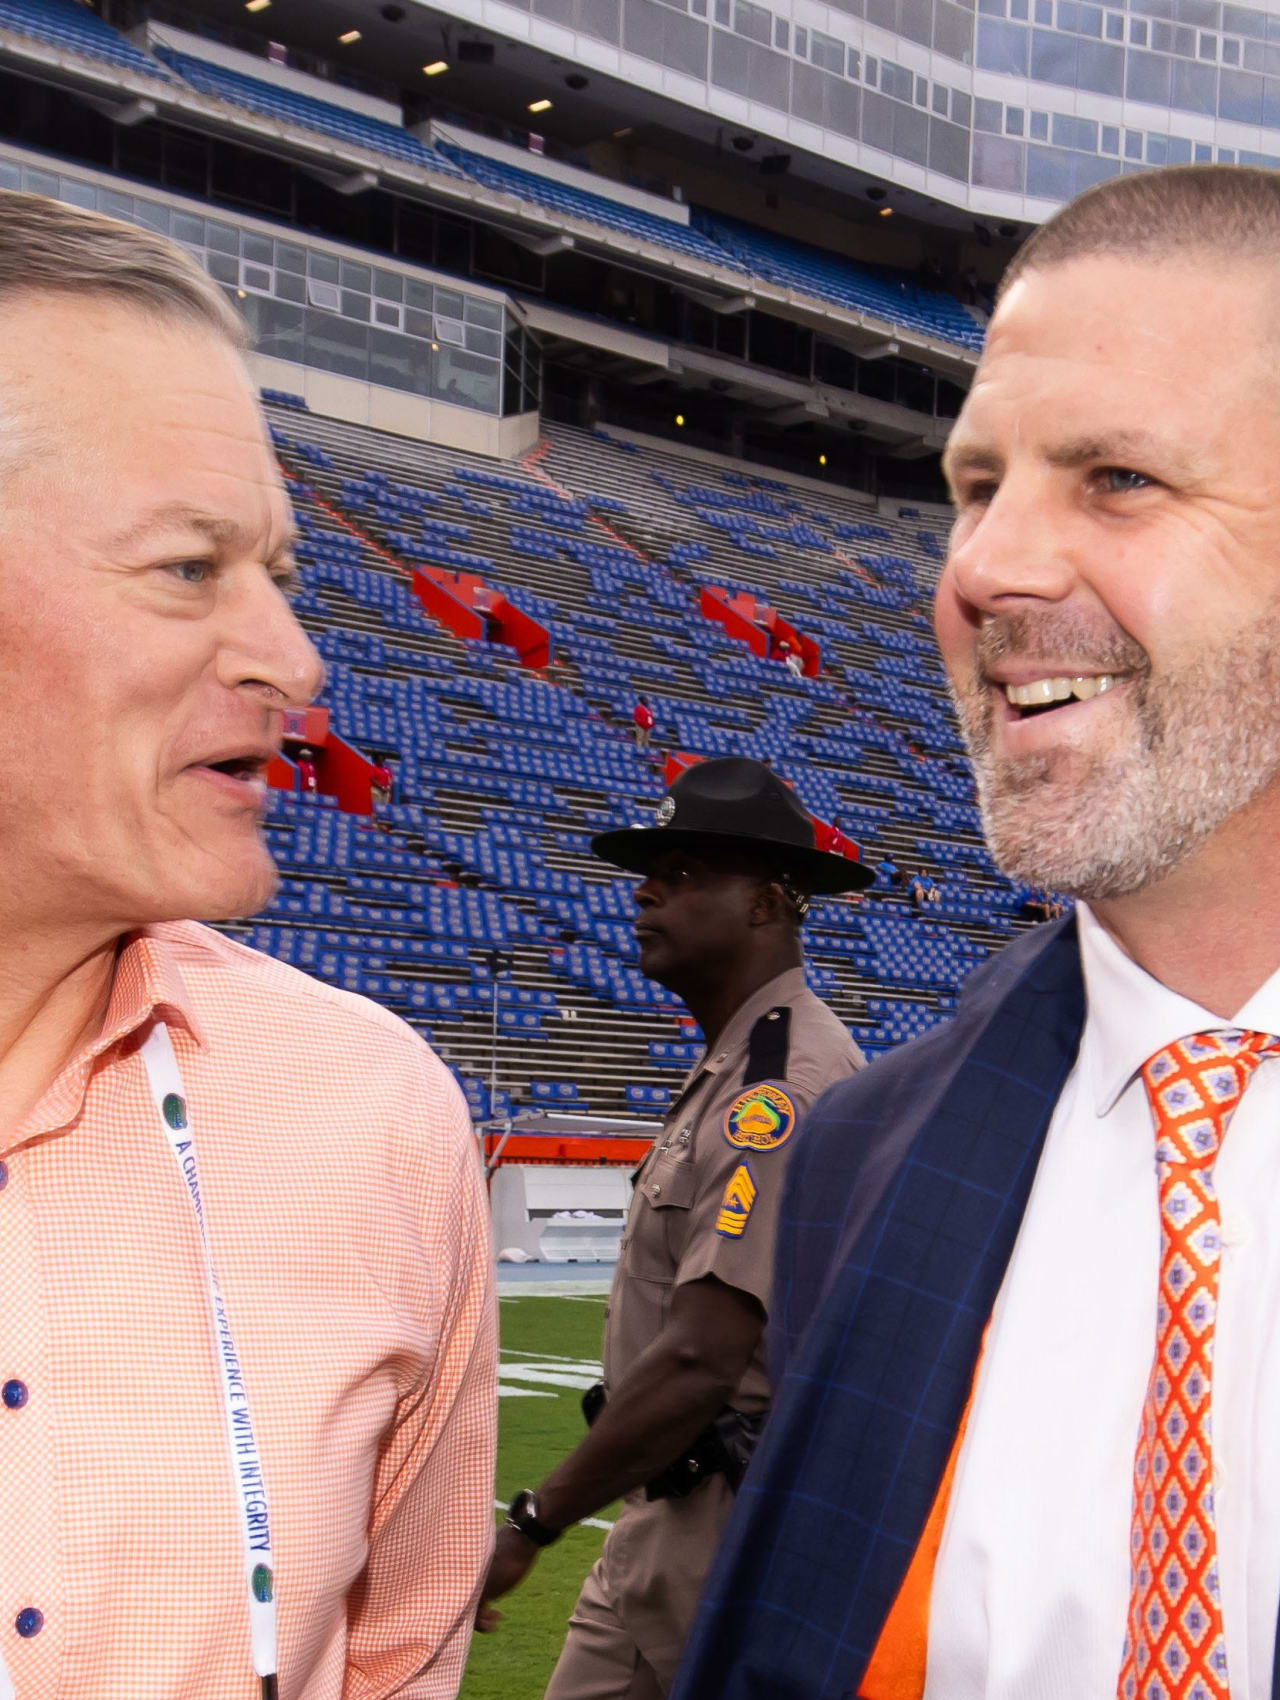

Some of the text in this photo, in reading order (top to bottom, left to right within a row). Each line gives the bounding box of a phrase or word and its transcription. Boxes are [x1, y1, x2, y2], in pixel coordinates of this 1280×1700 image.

[175, 1140, 192, 1155] A
[215, 1296, 246, 1402] EXPERIENCE
[231, 1408, 257, 1455] WITH
[239, 1460, 270, 1552] INTEGRITY
